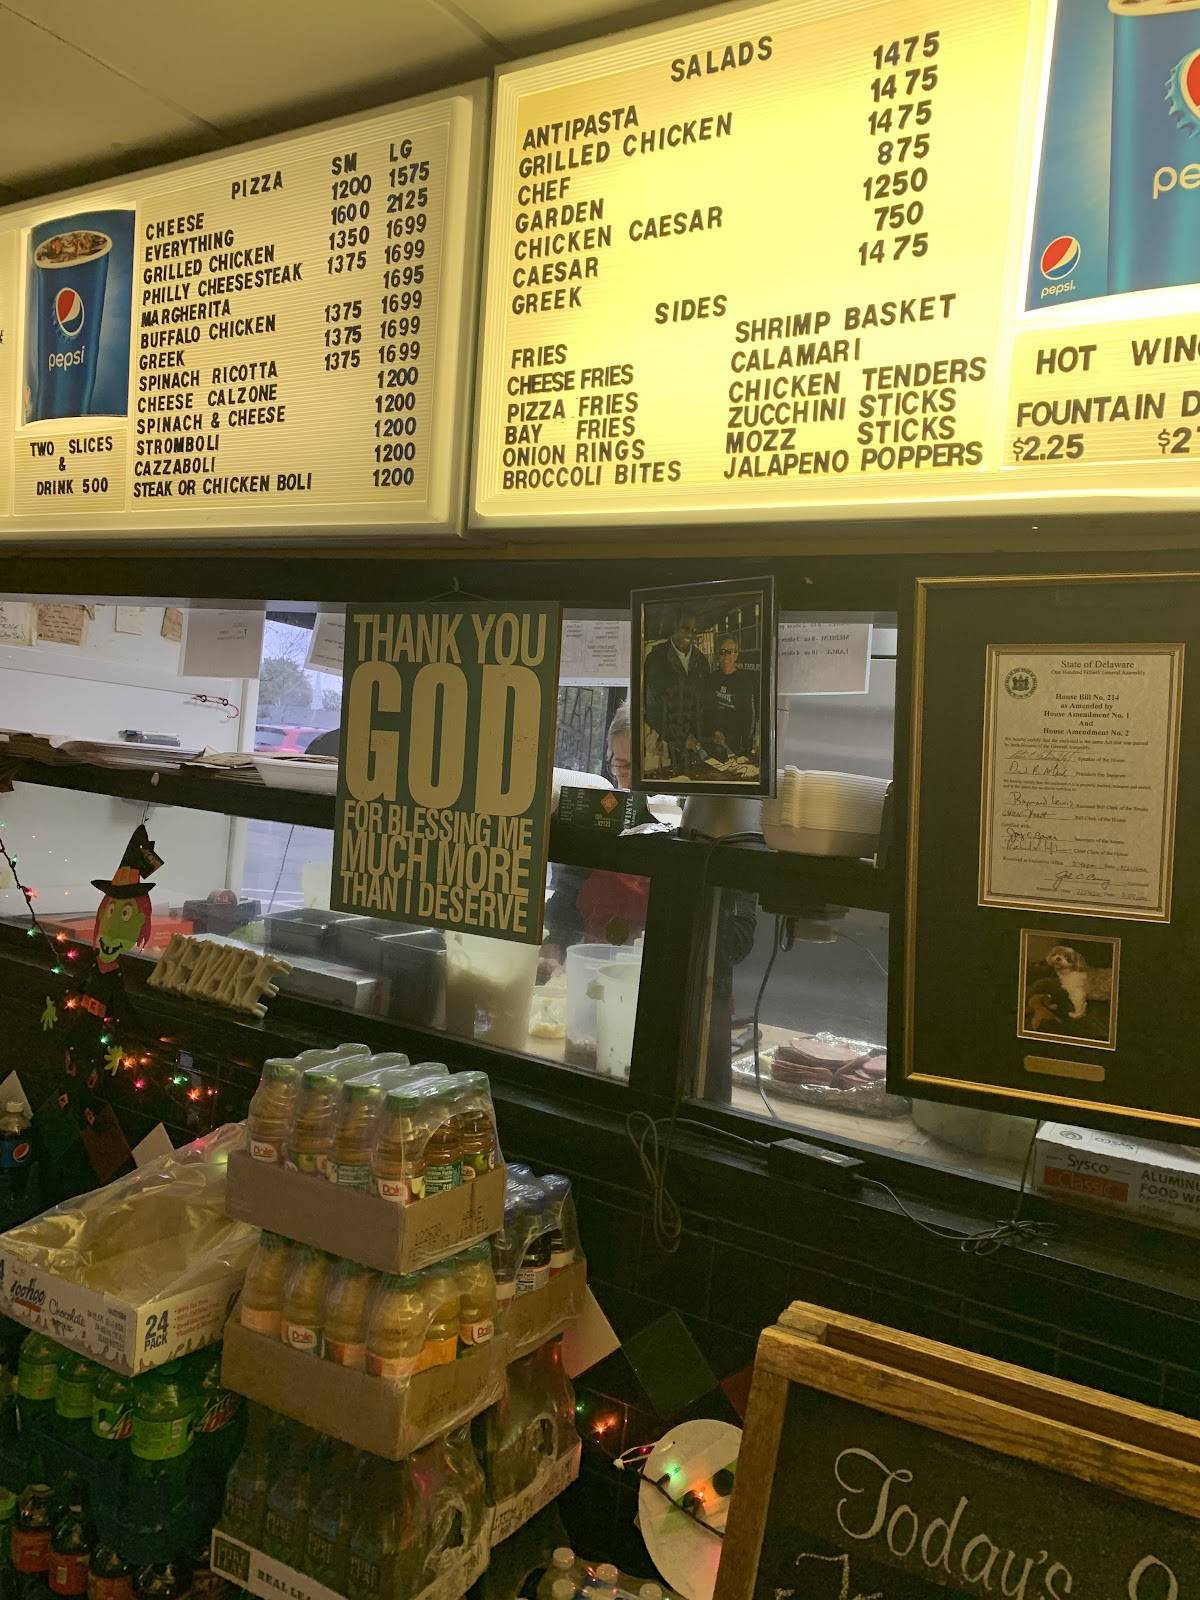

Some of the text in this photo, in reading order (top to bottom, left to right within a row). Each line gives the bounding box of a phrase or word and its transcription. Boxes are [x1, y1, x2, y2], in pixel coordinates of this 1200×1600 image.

[671, 35, 773, 82] SALADS
[873, 30, 940, 70] 1475
[871, 64, 938, 103] 1475
[522, 105, 639, 151] ANTIPASTA
[868, 99, 932, 136] 1475
[332, 139, 413, 176] SM LG
[519, 112, 733, 179] GRILLED CHICKEN
[878, 133, 930, 166] 875
[231, 171, 283, 199] PIZZA
[332, 161, 430, 200] 1200 1575
[517, 176, 571, 207] CHEF
[863, 167, 928, 201] 1250
[331, 187, 428, 225] 1600 2125
[515, 198, 605, 234] GARDEN
[874, 200, 924, 231] 750
[146, 212, 204, 240] CHEESE
[329, 213, 427, 250] 1350 1699
[514, 206, 723, 261] CHICKEN CAESAR
[145, 229, 234, 262] EVERYTHING
[327, 239, 425, 275] 1375 1699
[858, 232, 928, 266] 1475
[143, 244, 275, 284] GRILLED CHICKEN
[383, 264, 424, 289] 1695
[512, 256, 599, 288] CAESAR
[143, 262, 303, 305] PHILLY CHEESESTEAK
[141, 299, 231, 327] MARGHERITA
[324, 289, 423, 323] 1375 1699
[512, 286, 582, 315] GREEK
[655, 294, 728, 325] SIDES
[141, 314, 276, 349] BUFFALO CHICKEN
[324, 315, 421, 347] 1375 1699
[735, 293, 956, 343] SHRIMP BASKET
[48, 345, 86, 371] pepsi
[139, 350, 185, 370] GREEK
[324, 340, 421, 371] 1375 1699
[511, 344, 568, 369] FRIES
[731, 337, 861, 373] CALAMARI
[1036, 334, 1200, 375] HOT WIN
[139, 360, 278, 391] SPINACH RICOTTA
[377, 366, 419, 389] 1200
[507, 364, 634, 396] CHEESE FRIES
[728, 356, 988, 403] CHICKEN TENDERS
[137, 383, 278, 413] CHEESE CALZONE
[375, 391, 416, 413] 1200
[507, 391, 639, 423] PIZZA FRIES
[728, 387, 957, 428] ZUCCHINI STICKS
[1016, 392, 1166, 428] FOUNTAIN
[137, 405, 286, 434] SPINACH & CHEESE
[374, 416, 417, 438] 1200
[504, 415, 636, 445] BAY FRIES
[725, 415, 956, 454] MOZZ STICKS
[30, 436, 113, 456] TWO SLICES
[137, 434, 220, 455] STROMBOLI
[374, 441, 416, 463] 1200
[502, 438, 646, 468] ONION RINGS
[1012, 426, 1200, 462] $2.25 $2
[58, 456, 66, 471] &
[134, 457, 216, 476] CAZZABOLI
[502, 460, 682, 490] BROCCOLI BITES
[724, 441, 983, 480] JALAPENO POPPERS
[36, 477, 109, 496] DRINK 500
[133, 472, 312, 498] STEAK OR CHICKEN BOLI
[372, 467, 415, 487] 1200
[353, 612, 463, 664] THANK
[471, 612, 548, 667] YOU
[1061, 660, 1135, 669] State of Delaware
[1067, 711, 1110, 719] Amendment
[345, 661, 542, 818] GOD
[1066, 728, 1109, 736] Amendment
[344, 800, 533, 851] FOR BLESSING ME
[341, 831, 532, 898] MUCH MORE
[340, 870, 529, 934] THAN I DESERVE
[1067, 1154, 1110, 1174] Sysco
[1141, 1183, 1179, 1199] FOOD
[145, 1309, 169, 1340] 24
[143, 1332, 169, 1352] PACK
[257, 1568, 288, 1593] REAL
